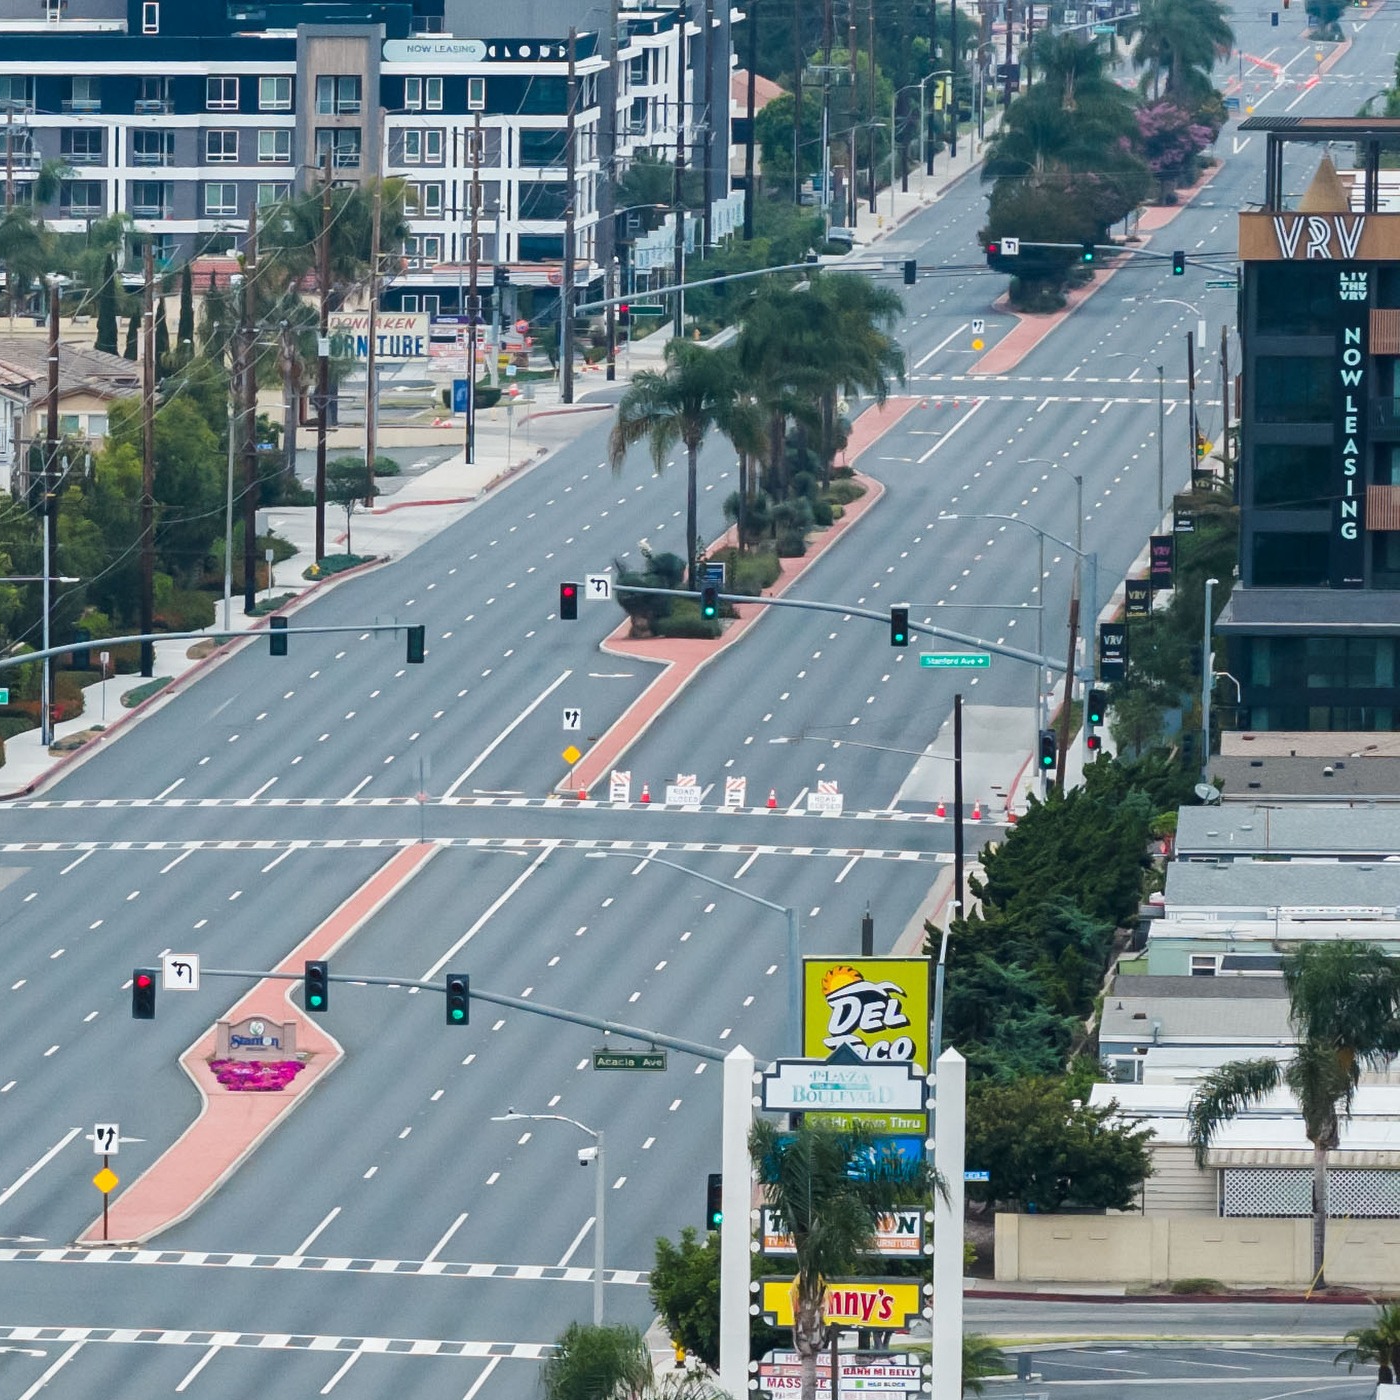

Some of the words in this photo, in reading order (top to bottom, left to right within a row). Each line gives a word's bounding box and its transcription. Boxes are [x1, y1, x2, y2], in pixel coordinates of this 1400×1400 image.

[1273, 215, 1365, 259] VRV
[1340, 272, 1367, 281] LIV
[1340, 282, 1367, 291] THE
[1339, 291, 1368, 300] VRV
[1340, 327, 1363, 386] NOW
[1341, 395, 1359, 540] LEASING
[826, 994, 908, 1036] DEL
[231, 1034, 283, 1050] Stanton
[597, 1057, 635, 1067] Acacia
[643, 1058, 663, 1067] Ave
[890, 1117, 921, 1128] Thru
